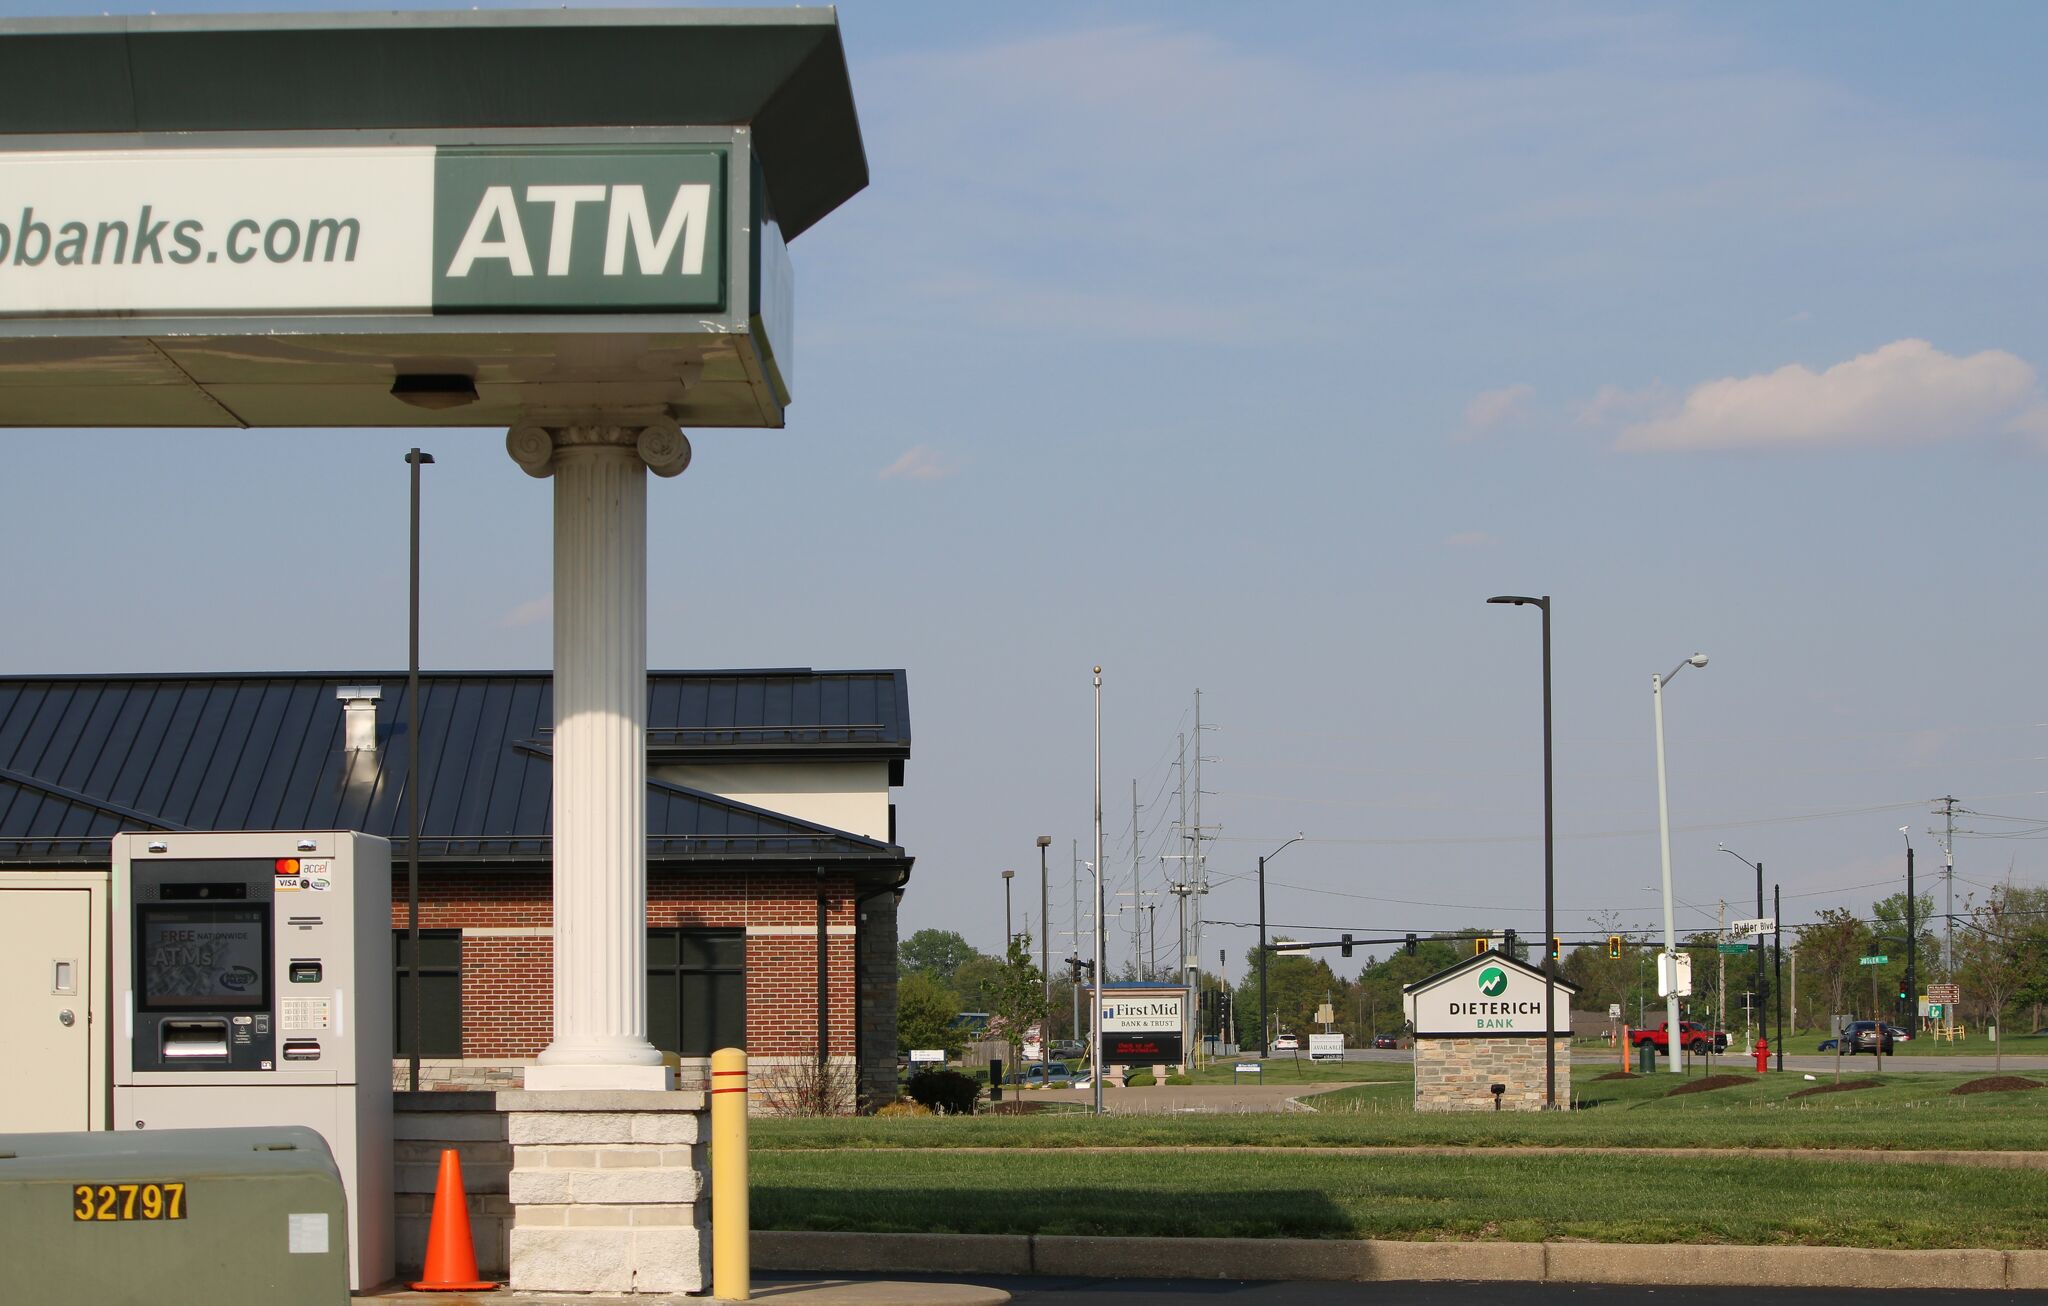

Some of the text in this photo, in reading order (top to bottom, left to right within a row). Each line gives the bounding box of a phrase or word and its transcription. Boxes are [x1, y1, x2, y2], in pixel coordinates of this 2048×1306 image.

[446, 184, 710, 277] ATM
[304, 861, 327, 873] accel
[1760, 922, 1773, 931] Blvd
[160, 930, 248, 942] FREE NATIONWIDE
[152, 947, 213, 967] ATMs
[1116, 1003, 1178, 1016] First Mid
[1449, 1002, 1541, 1015] DIETERICH
[1477, 1019, 1514, 1029] BANK
[75, 1183, 184, 1221] 32797
